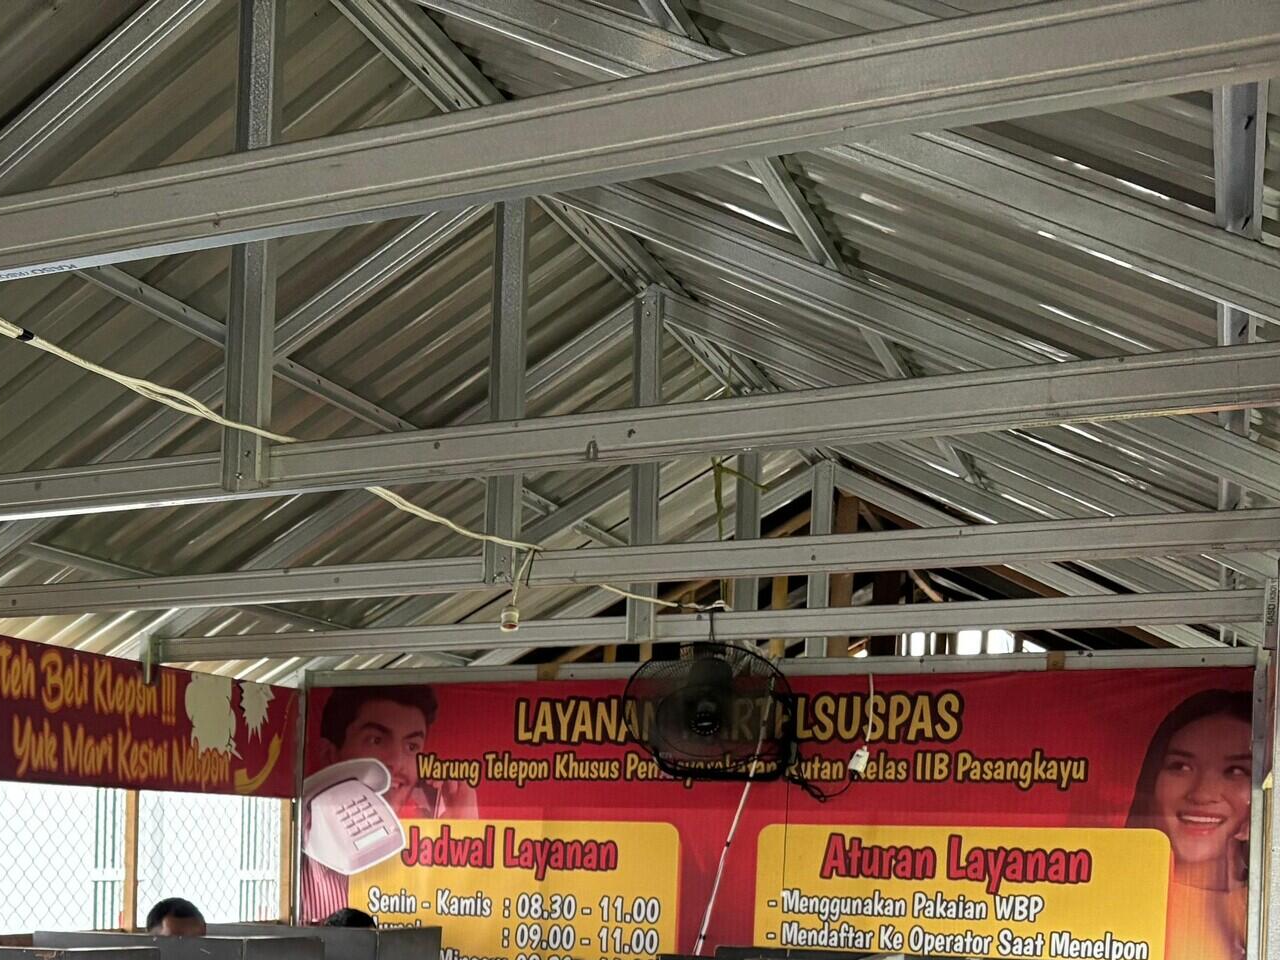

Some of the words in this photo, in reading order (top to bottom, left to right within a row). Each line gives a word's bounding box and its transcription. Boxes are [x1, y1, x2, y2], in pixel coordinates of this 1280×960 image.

[40, 649, 89, 714] Beli
[13, 712, 58, 778] Yuk
[63, 719, 114, 776] Mari
[118, 726, 169, 783] Kesini
[417, 752, 480, 787] Warung
[485, 753, 549, 788] Telepon
[554, 753, 620, 781] Khusus
[915, 754, 950, 782] IIB
[955, 752, 1088, 790] Pasangkayu
[402, 824, 495, 869] Jadwal
[503, 827, 619, 880] Layanan
[820, 833, 936, 880] Aturan
[947, 835, 1093, 893] Layanan
[368, 886, 417, 913] Senin
[436, 888, 493, 917] Kamis
[516, 893, 576, 921] 08.30
[599, 896, 661, 923] 11.00
[781, 890, 907, 924] Menggunakan
[912, 892, 988, 921] Pakaian
[993, 895, 1045, 923] WBP
[515, 923, 575, 950] 09.00
[598, 926, 660, 955] 11.00
[781, 921, 874, 950] Mendaftar
[879, 924, 903, 951] Ke
[908, 926, 992, 956] Operator
[998, 930, 1045, 957] Saat
